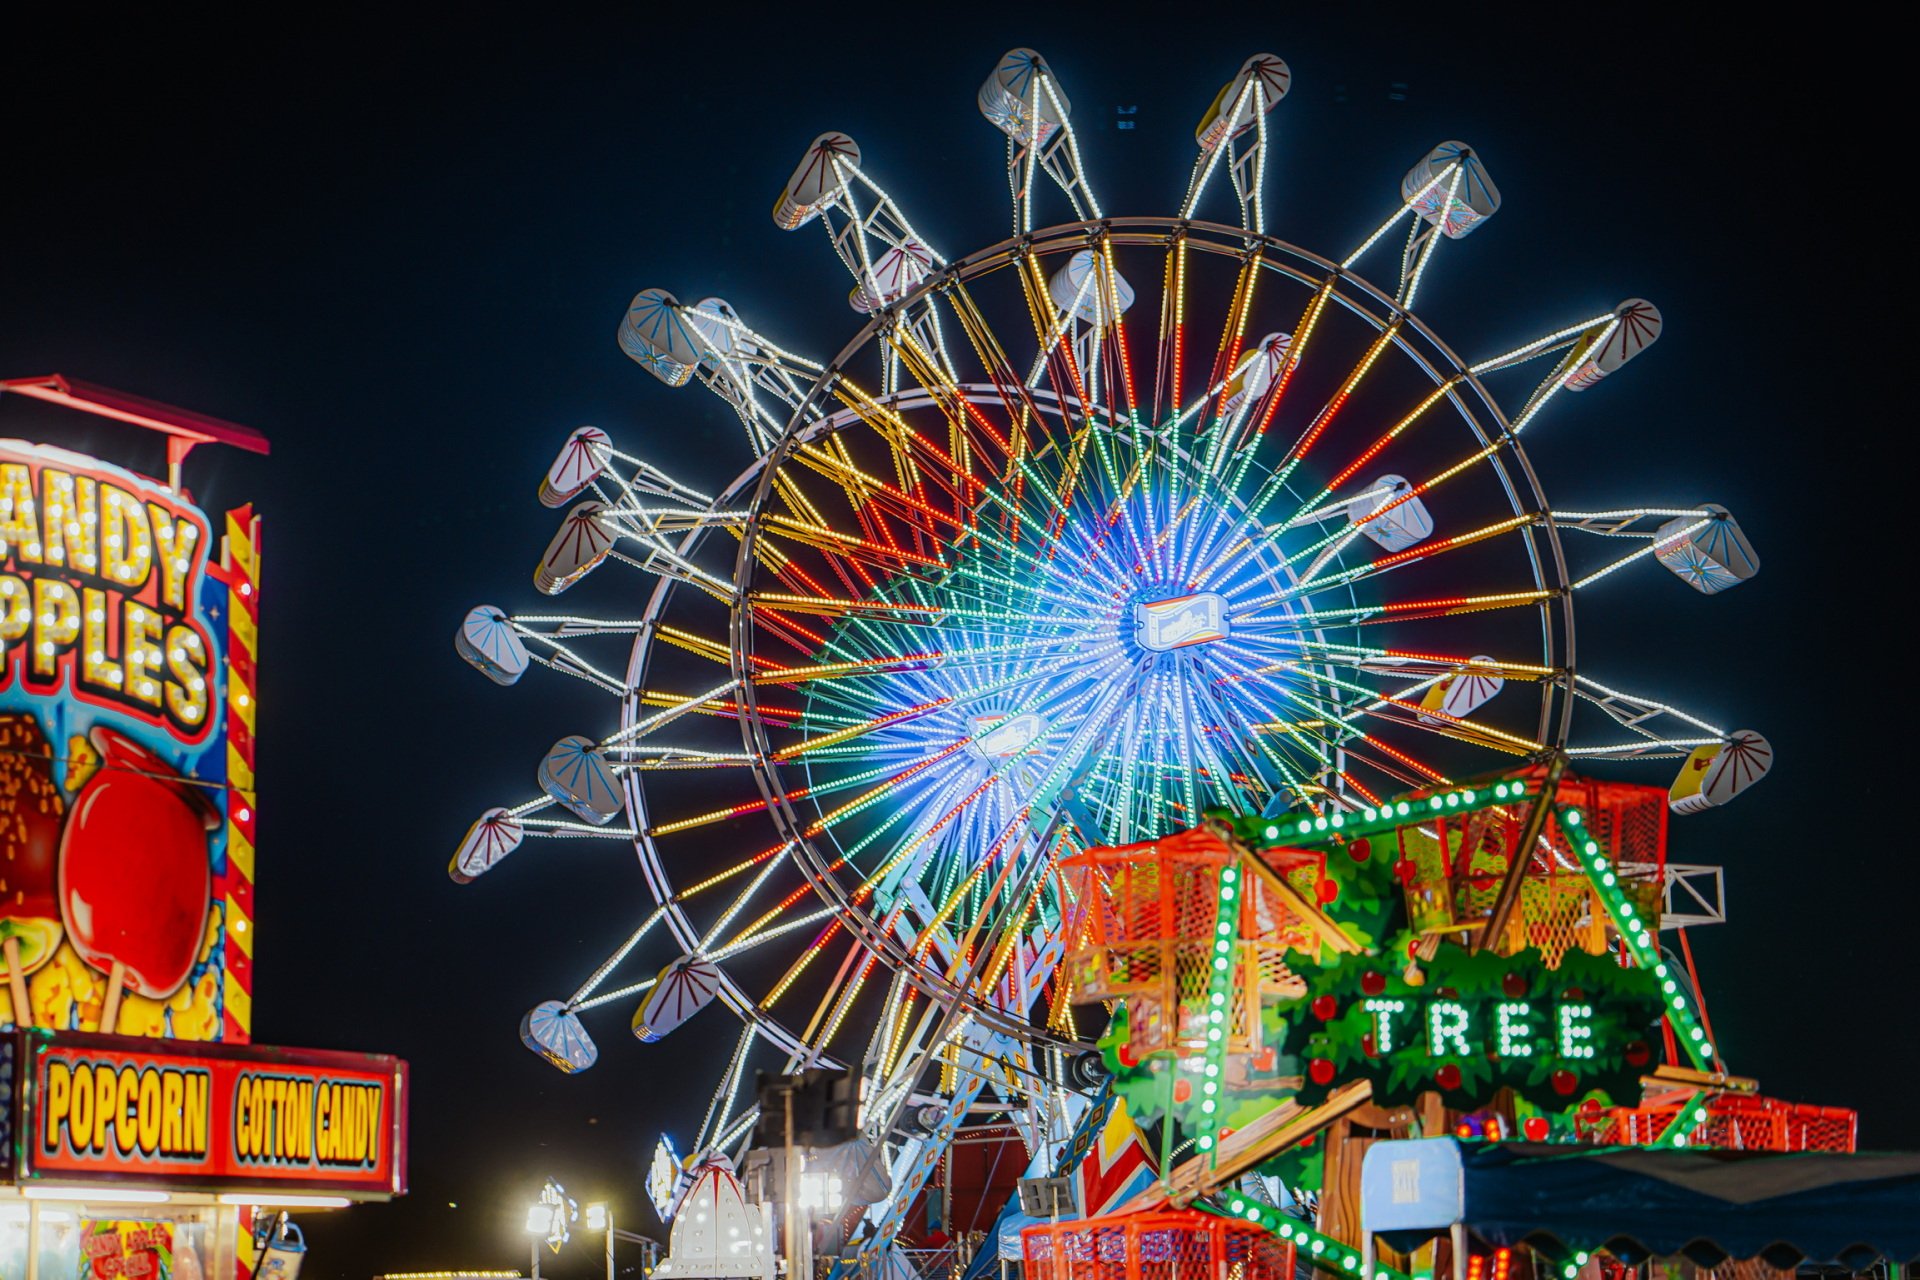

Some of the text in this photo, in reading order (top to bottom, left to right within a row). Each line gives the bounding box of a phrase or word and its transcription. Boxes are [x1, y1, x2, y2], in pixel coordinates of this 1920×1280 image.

[1359, 999, 1595, 1059] TREE
[44, 1061, 211, 1161] POPCORN
[235, 1073, 382, 1169] COTTON CANDY
